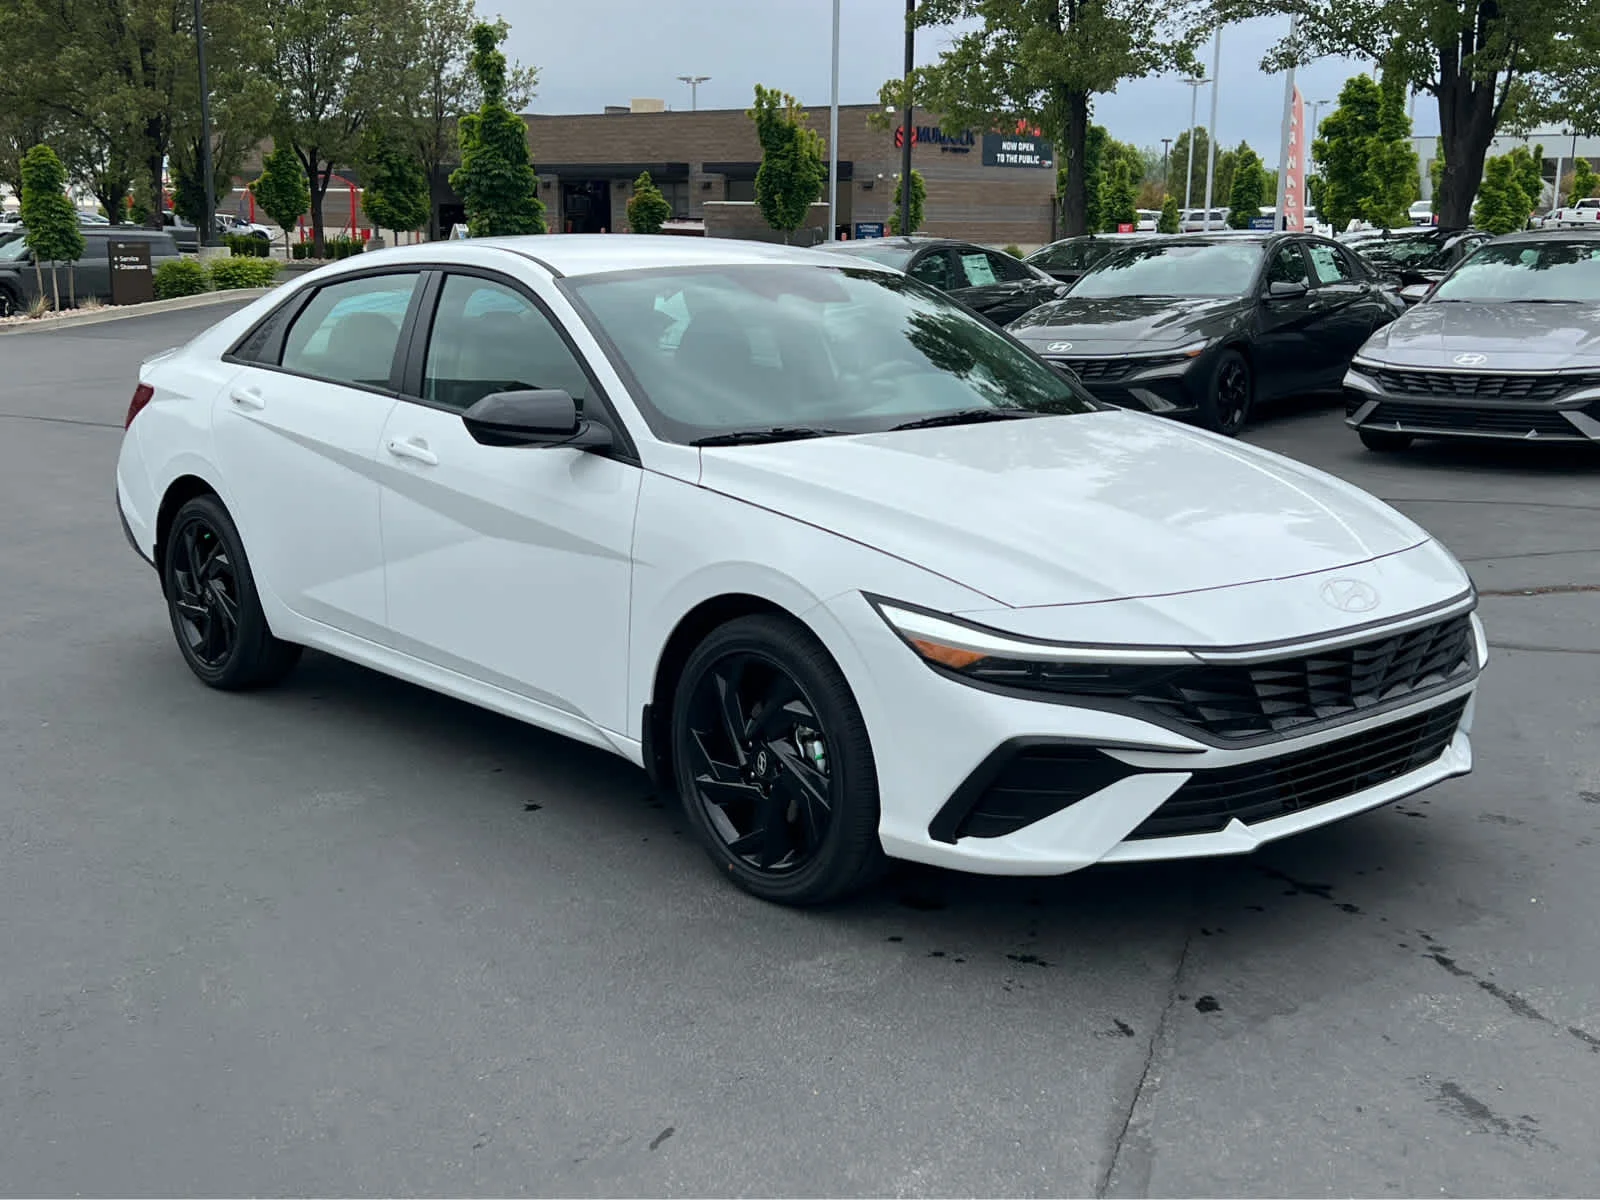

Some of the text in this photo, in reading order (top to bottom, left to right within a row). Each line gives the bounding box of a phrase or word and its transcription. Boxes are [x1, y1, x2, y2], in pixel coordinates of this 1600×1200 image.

[1002, 141, 1035, 152] NOW OPEN
[996, 153, 1005, 163] TO
[1006, 153, 1018, 163] THE
[1018, 154, 1040, 164] PUBLIC
